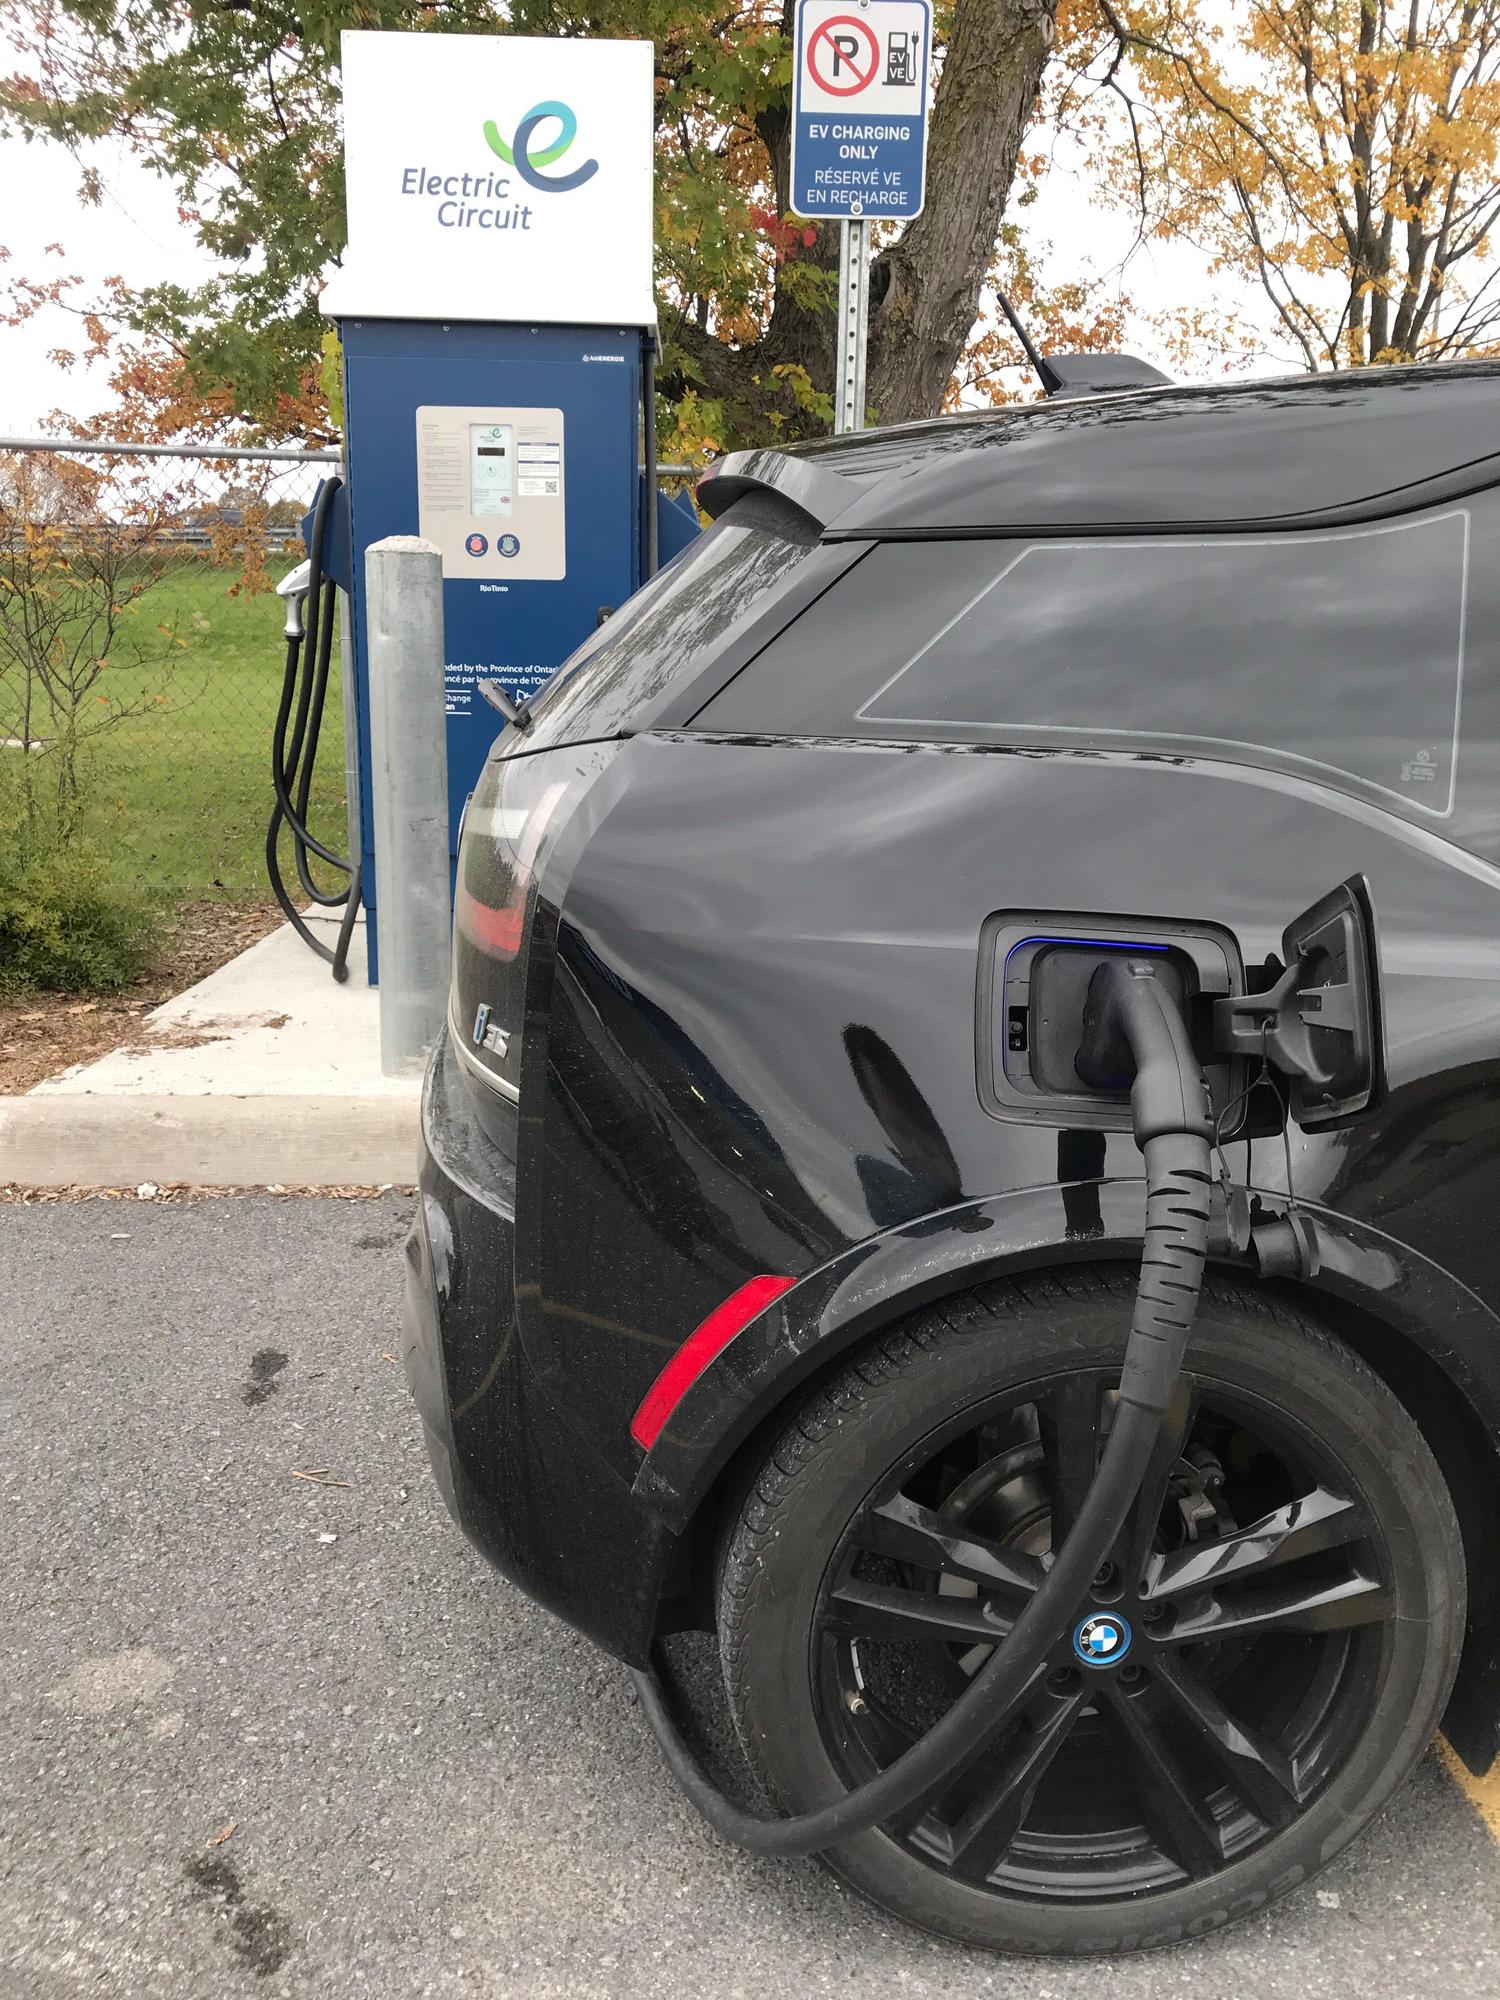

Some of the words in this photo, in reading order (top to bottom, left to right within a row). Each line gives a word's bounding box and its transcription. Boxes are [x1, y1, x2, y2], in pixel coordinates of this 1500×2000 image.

[833, 35, 859, 77] P
[889, 52, 906, 63] EV
[889, 67, 905, 79] VE
[809, 124, 829, 139] EV
[832, 125, 910, 141] CHARGING
[839, 145, 878, 160] ONLY
[401, 167, 510, 199] Electric
[815, 167, 880, 185] RÉSERVÉ
[883, 171, 901, 186] VE
[807, 189, 826, 204] EN
[830, 190, 908, 205] RECHARGE
[437, 201, 533, 230] Circuit
[464, 664, 474, 673] by
[475, 664, 488, 672] the
[490, 664, 523, 673] Province
[524, 664, 534, 673] of
[462, 676, 475, 684] par
[485, 676, 518, 684] rovince
[520, 676, 530, 684] de
[1081, 1621, 1096, 1656] BMW
